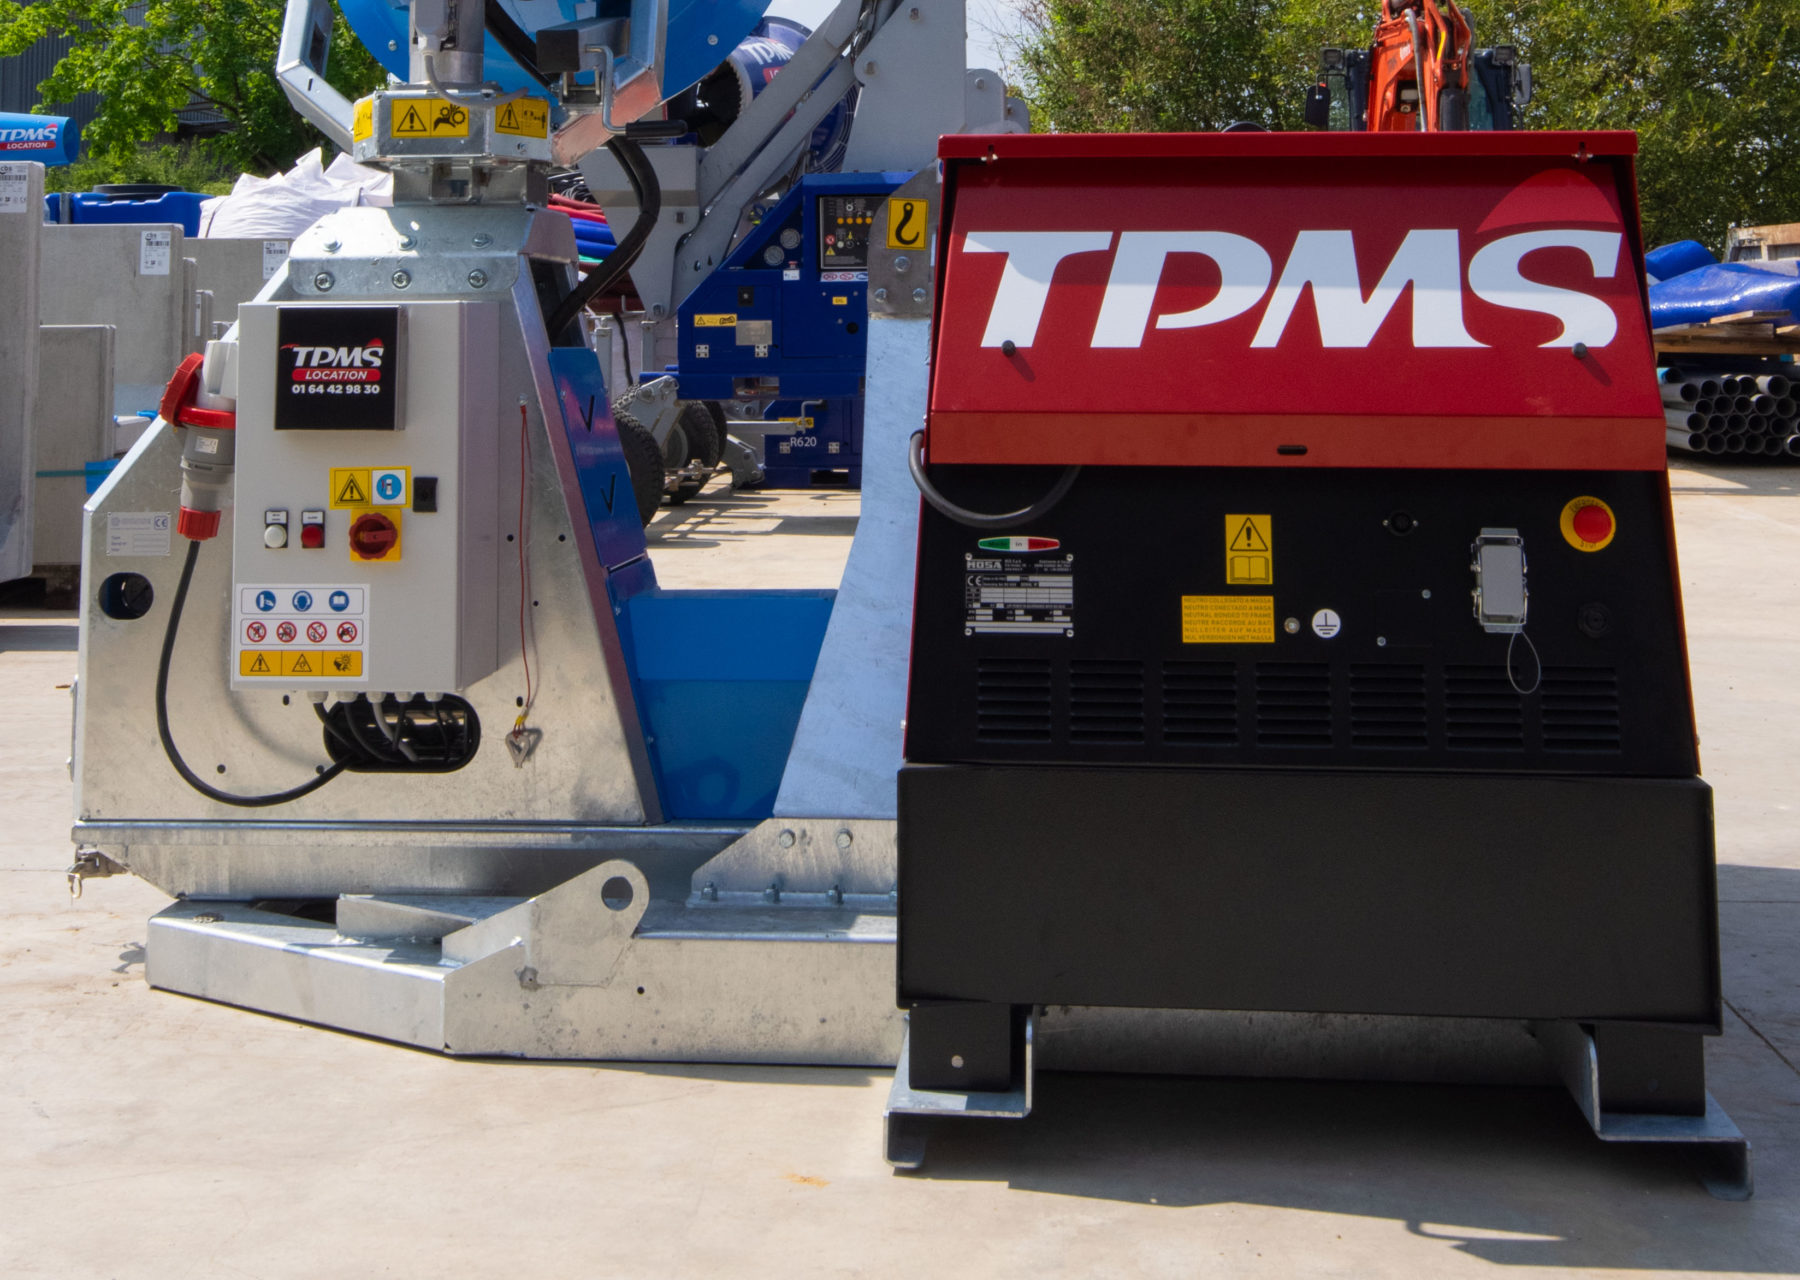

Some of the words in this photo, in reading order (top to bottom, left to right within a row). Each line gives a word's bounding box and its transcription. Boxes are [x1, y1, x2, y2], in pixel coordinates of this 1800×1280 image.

[0, 127, 58, 141] TPMS
[963, 229, 1622, 348] TPMS
[292, 346, 384, 367] TPMS
[305, 371, 367, 380] LOCATION
[292, 384, 306, 394] 01
[308, 384, 324, 394] 64
[327, 384, 343, 394] 42
[346, 384, 361, 394] 98
[364, 384, 380, 394] 30
[790, 436, 817, 447] R620
